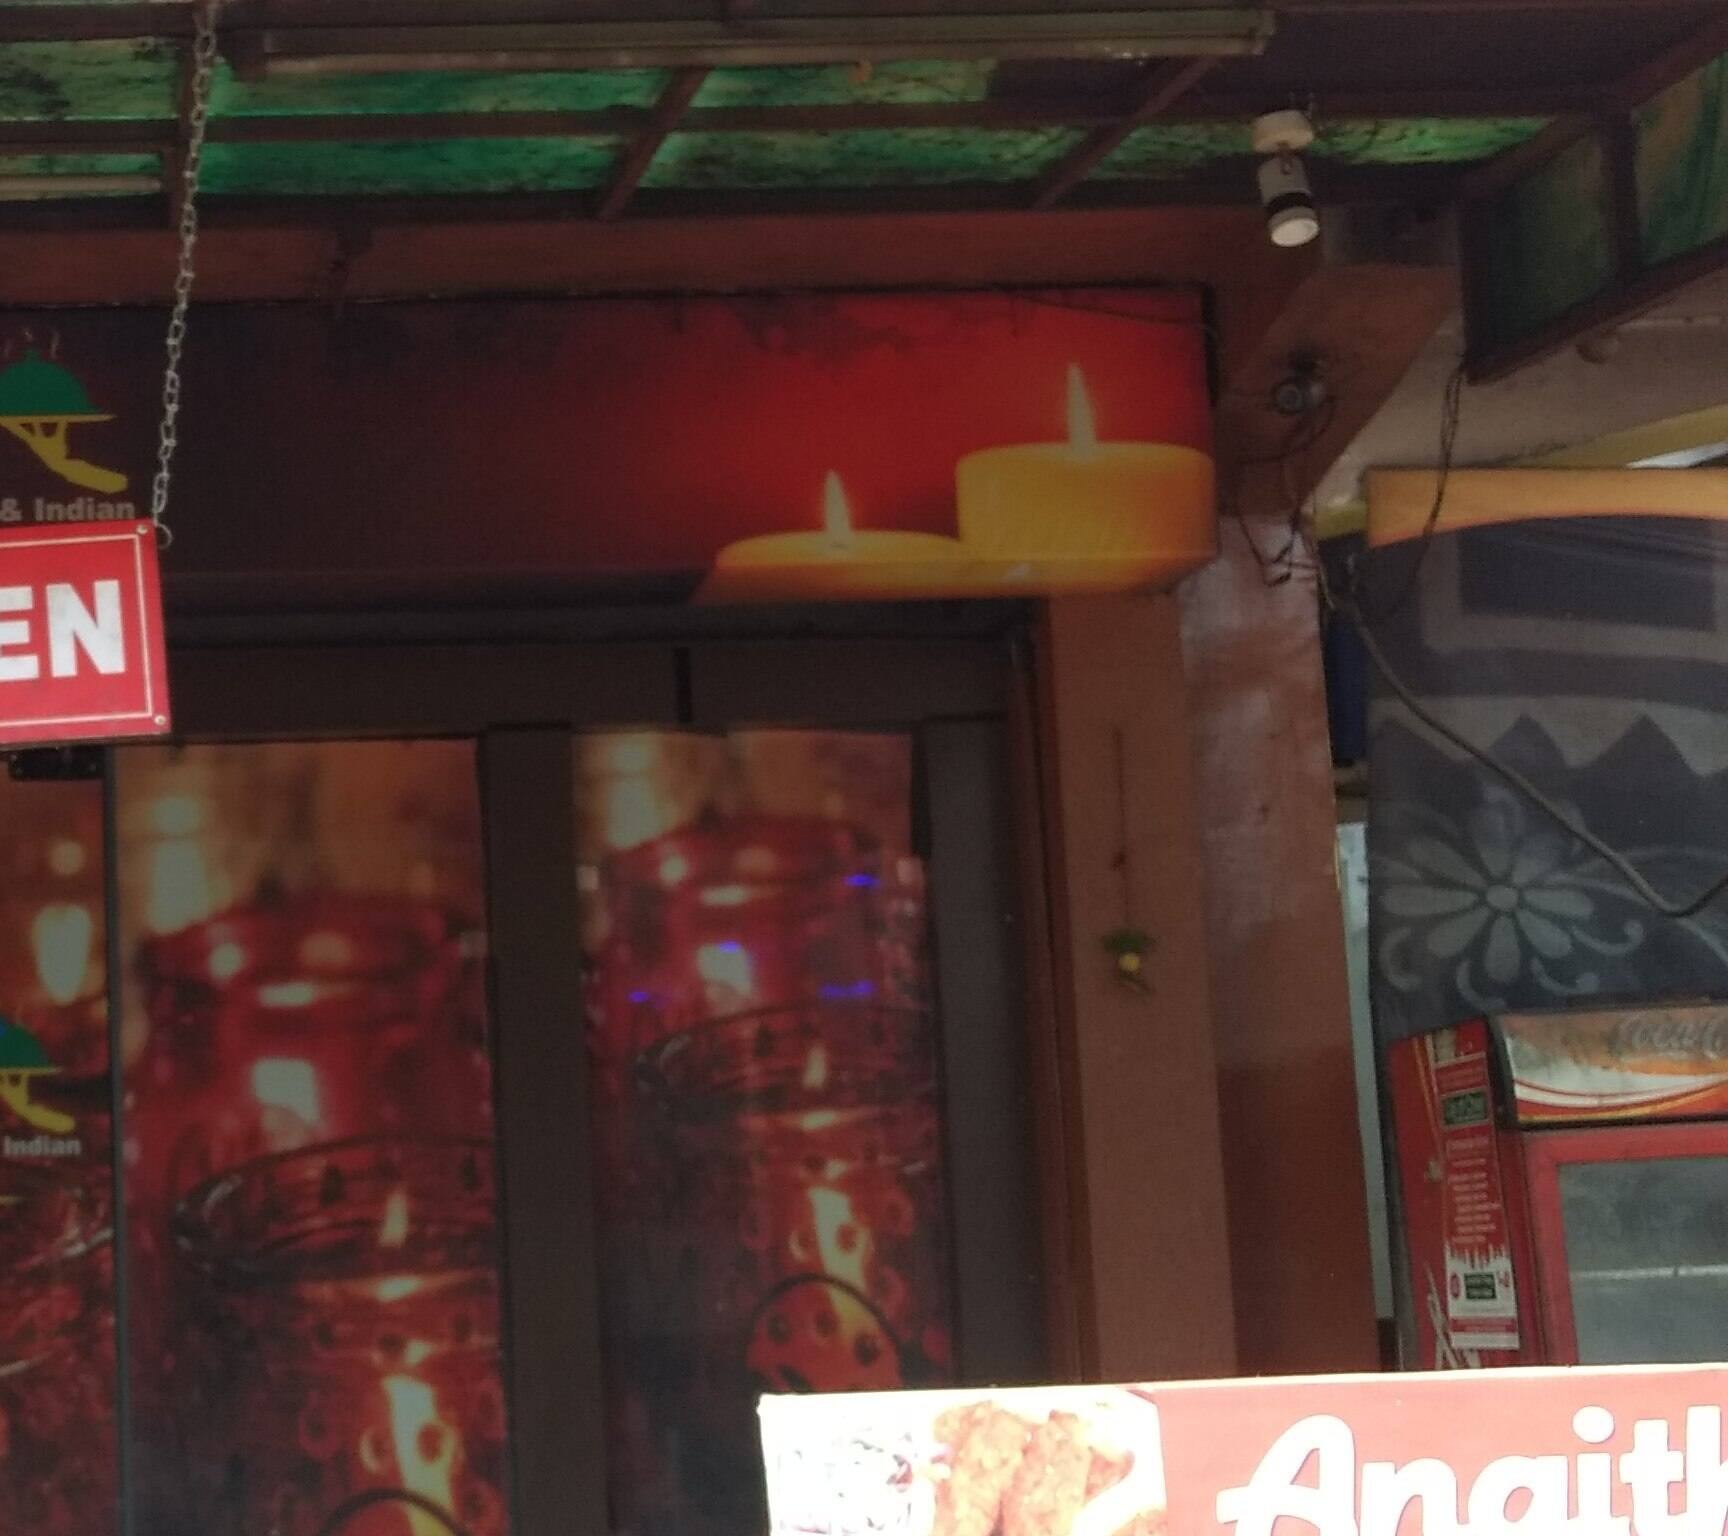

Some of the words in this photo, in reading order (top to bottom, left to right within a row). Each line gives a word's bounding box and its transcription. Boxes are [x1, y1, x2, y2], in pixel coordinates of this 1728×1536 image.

[0, 498, 23, 522] &
[34, 496, 136, 522] Indian
[3, 1135, 82, 1157] Indian
